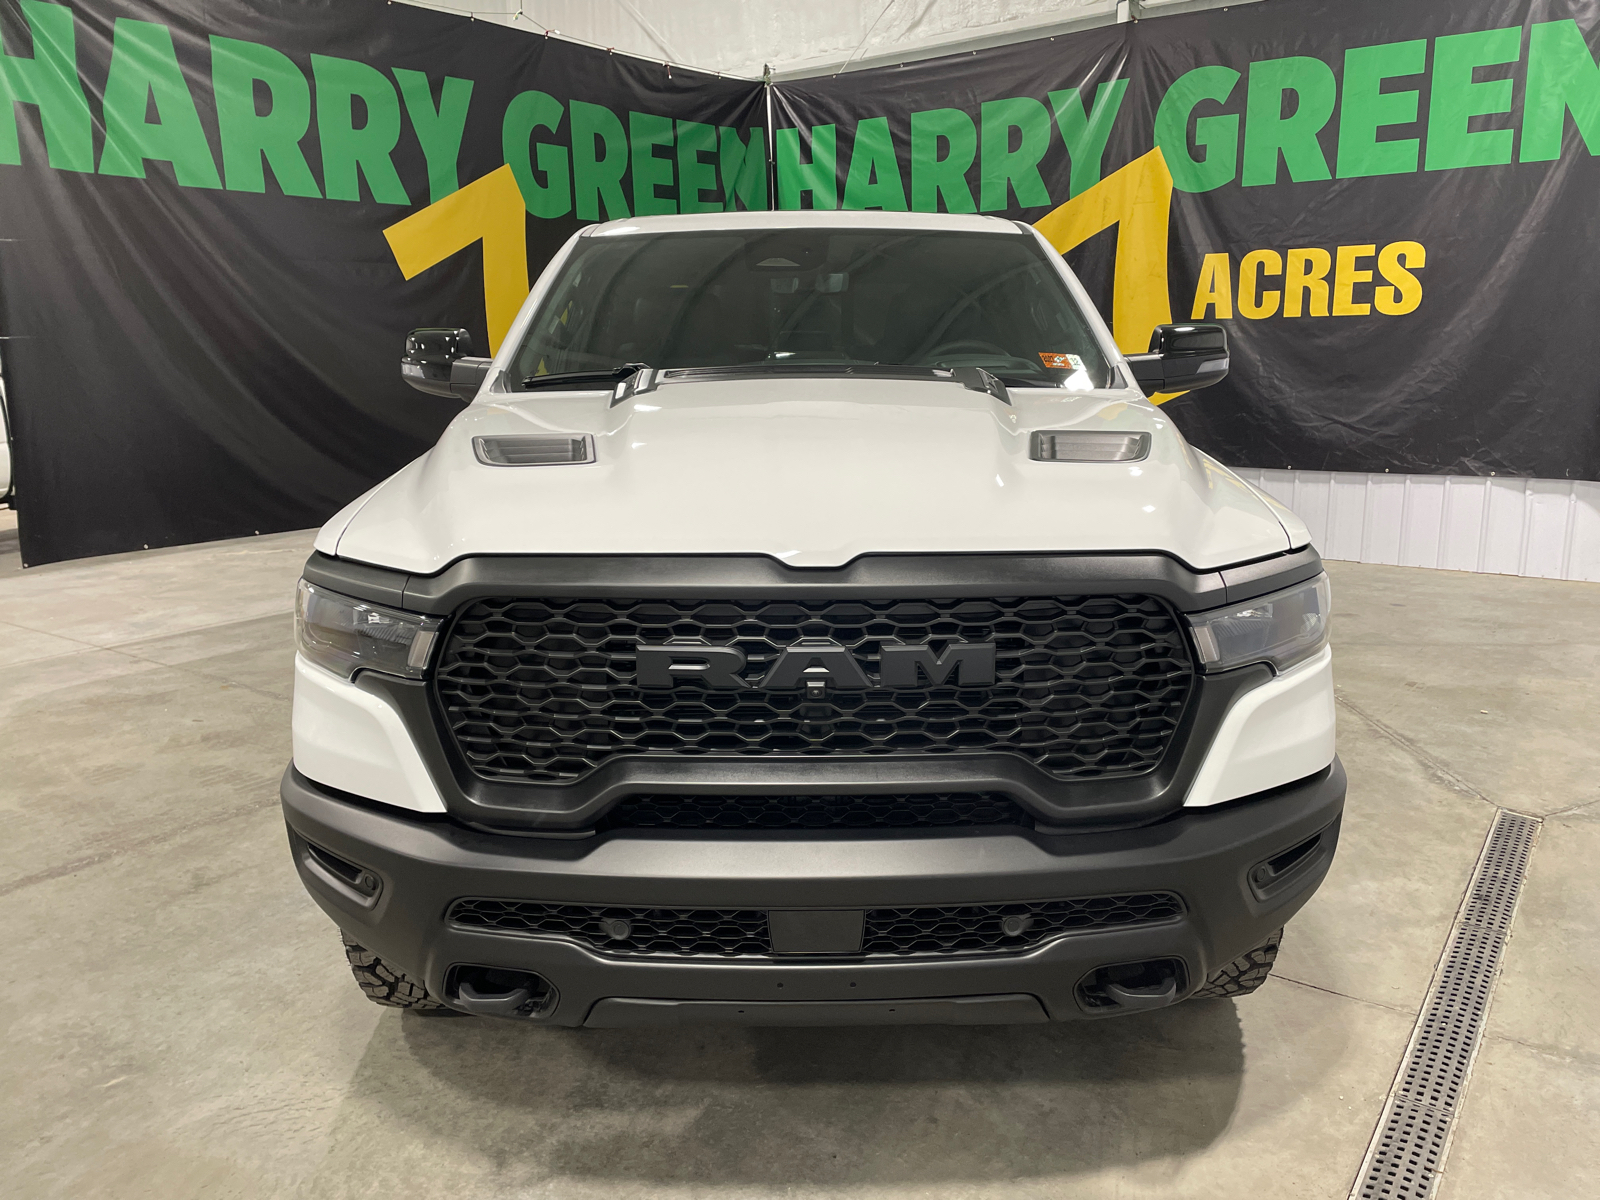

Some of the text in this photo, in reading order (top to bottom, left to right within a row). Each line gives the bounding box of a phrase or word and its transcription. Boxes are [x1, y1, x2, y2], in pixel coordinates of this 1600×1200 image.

[0, 0, 768, 221] HARRY GREEN
[776, 18, 1600, 214] HARRY GREEN
[1190, 240, 1427, 320] ACRES
[636, 643, 996, 688] RAM
